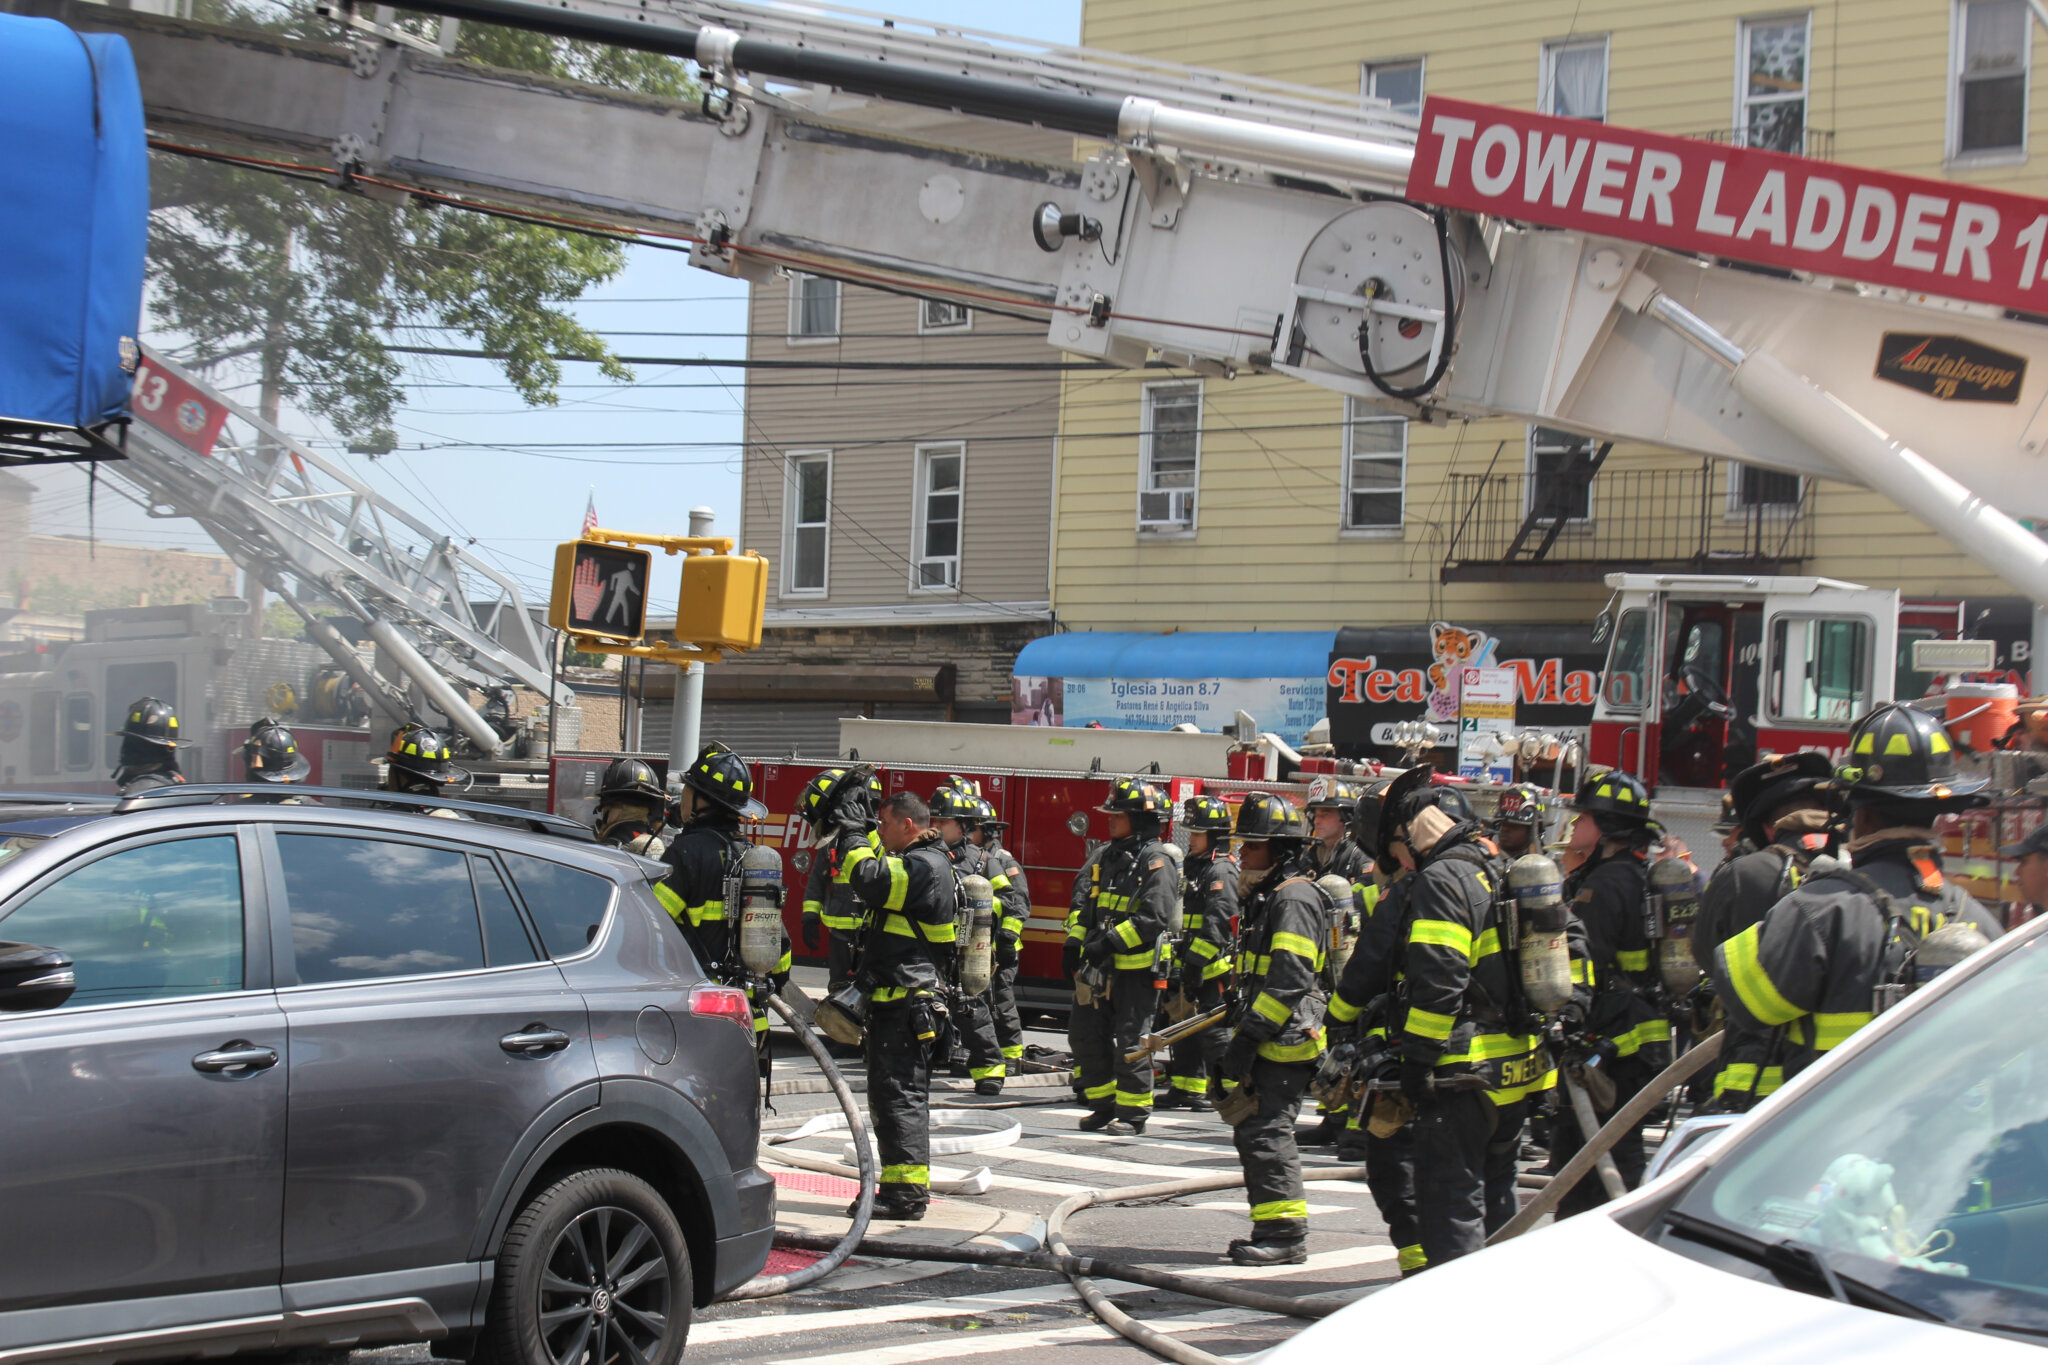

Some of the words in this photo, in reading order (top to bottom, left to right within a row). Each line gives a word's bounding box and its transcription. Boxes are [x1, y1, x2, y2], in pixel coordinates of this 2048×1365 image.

[1432, 115, 1682, 227] TOWER
[1696, 160, 2000, 281] LADDER
[2014, 213, 2048, 290] 1
[1328, 656, 1428, 704] Tea
[1111, 681, 1157, 698] Iglesia
[1161, 682, 1194, 696] Juan
[1198, 682, 1221, 696] 8.7
[1279, 684, 1325, 696] Servicios
[1116, 700, 1142, 711] Pastores
[1465, 717, 1475, 731] 2
[754, 912, 779, 920] SCOTT
